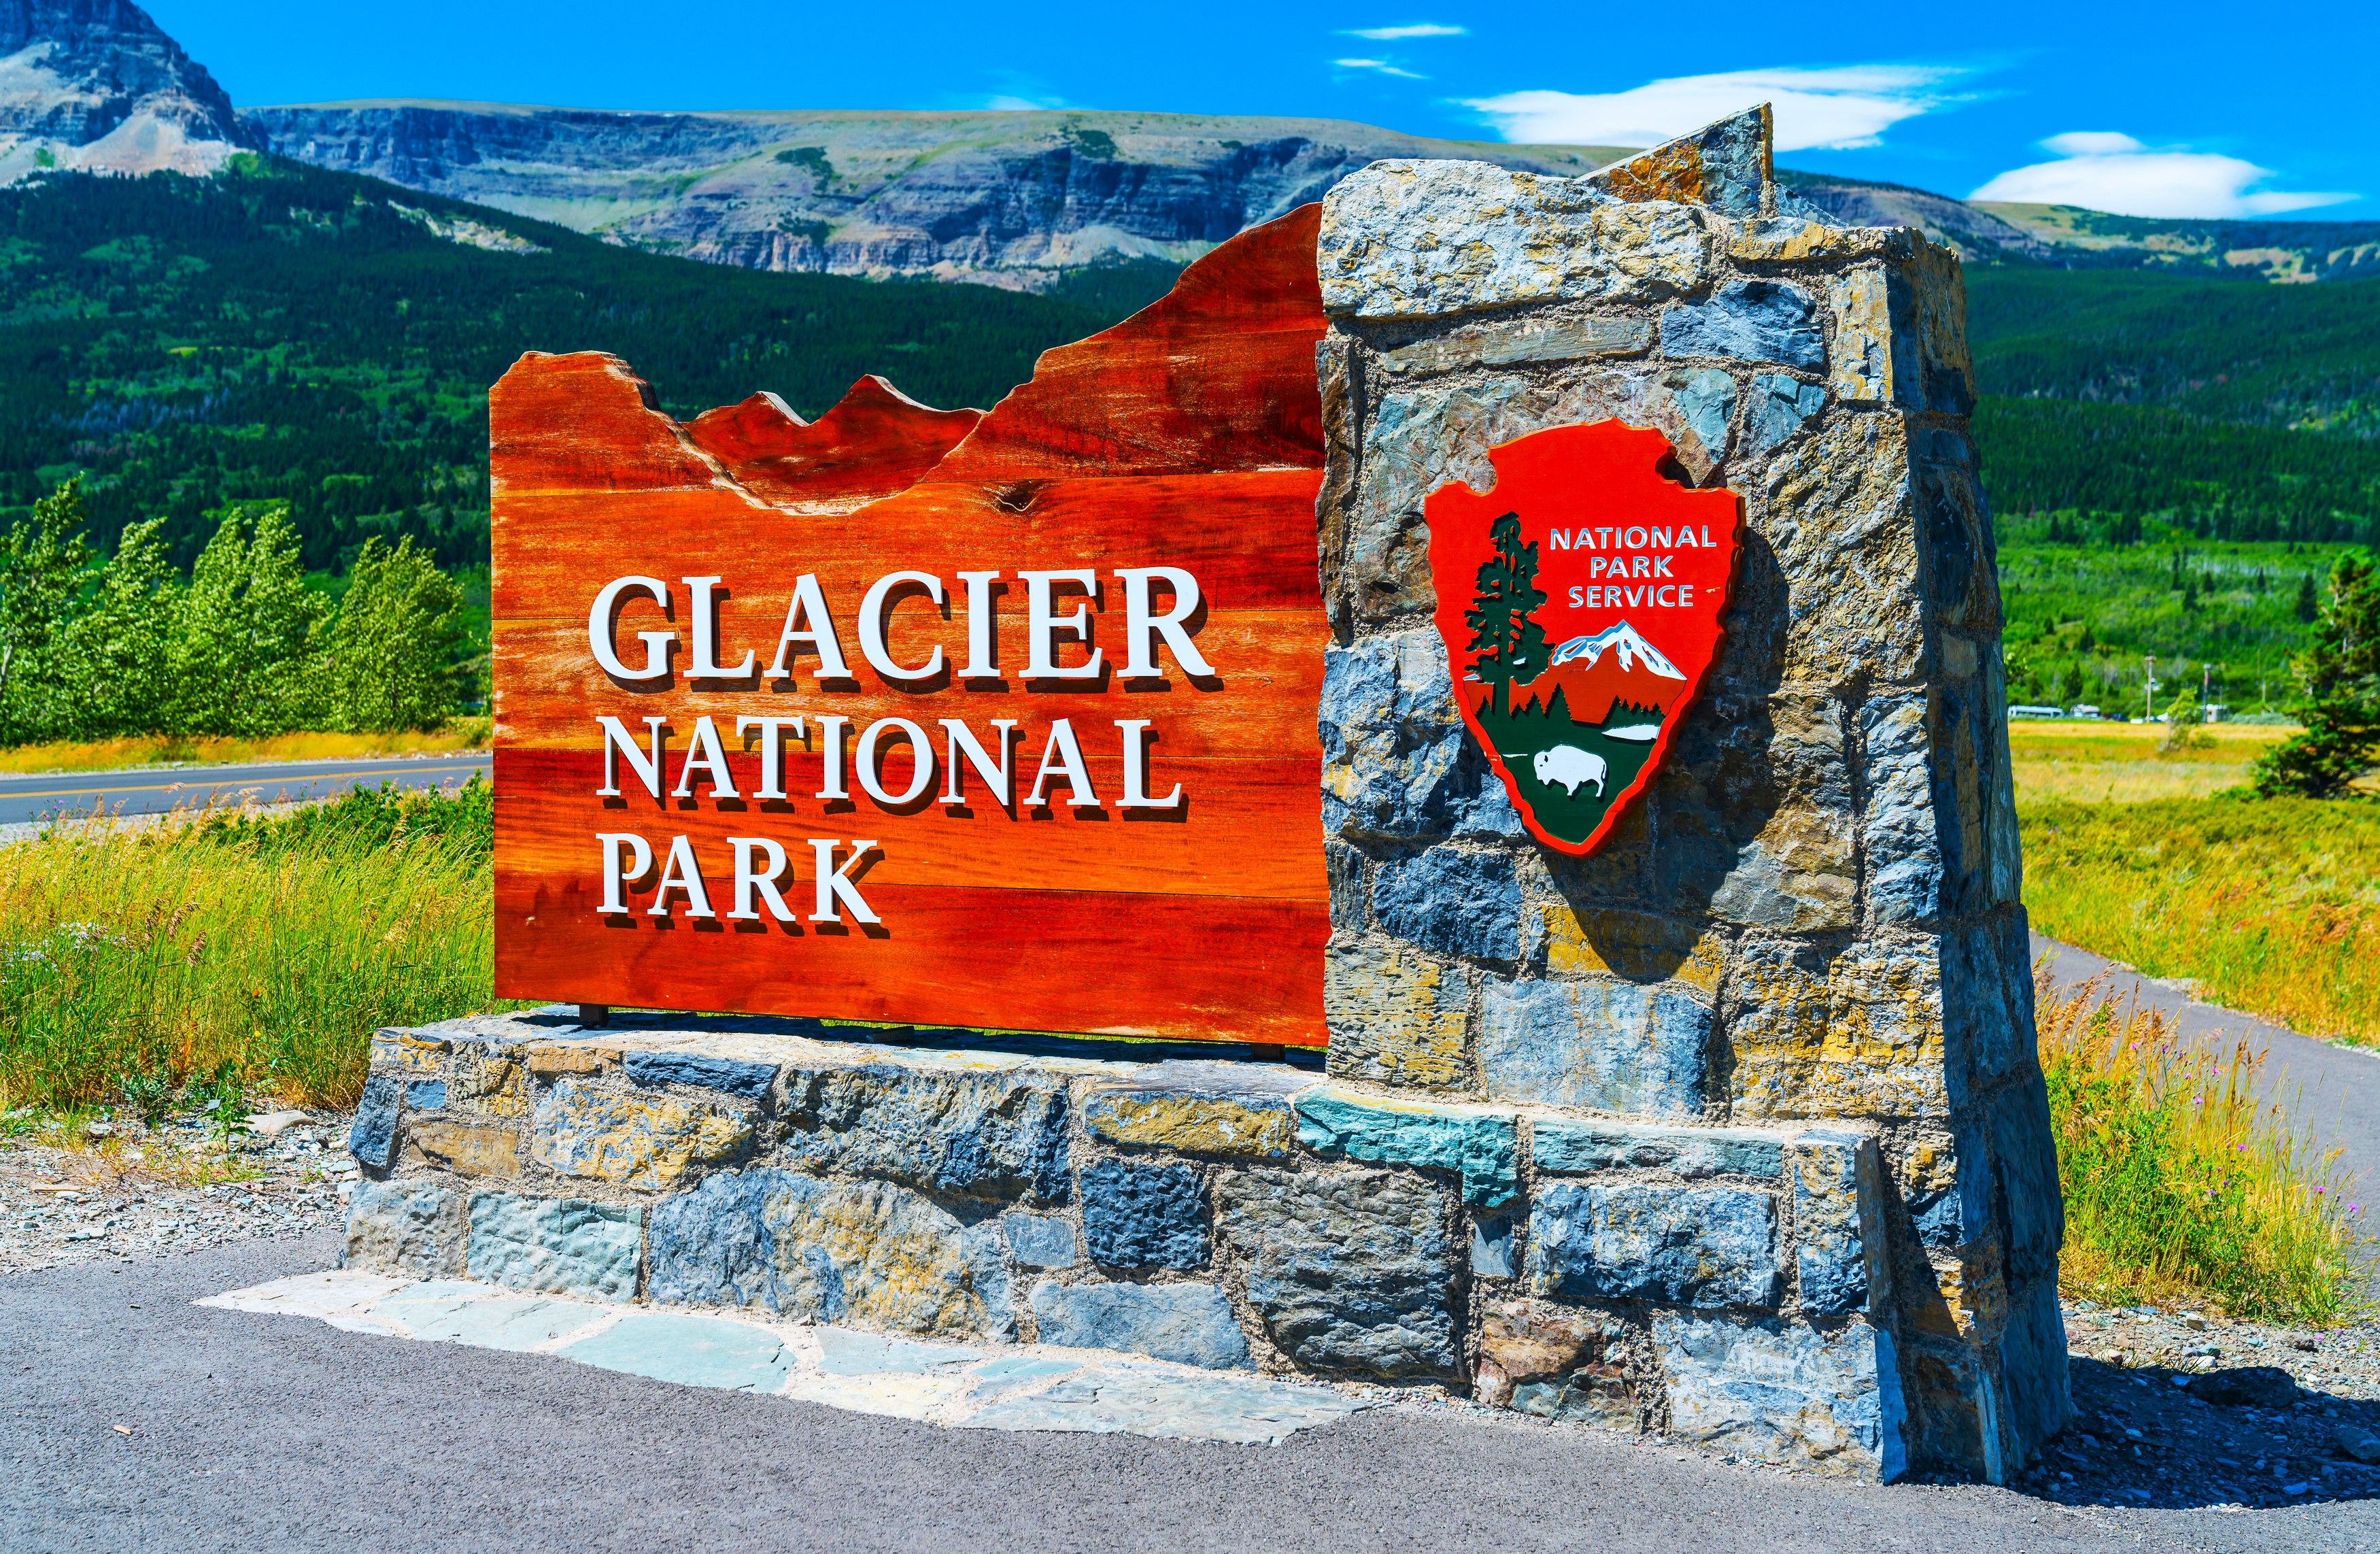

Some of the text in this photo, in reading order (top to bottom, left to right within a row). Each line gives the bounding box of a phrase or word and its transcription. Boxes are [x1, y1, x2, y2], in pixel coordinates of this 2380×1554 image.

[1550, 525, 1717, 550] NATIONAL
[1591, 555, 1674, 579] PARK
[588, 566, 1215, 679] GLACIER
[1568, 585, 1695, 608] SERVICE
[595, 713, 1182, 808] NATIONAL
[595, 832, 881, 924] PARK
